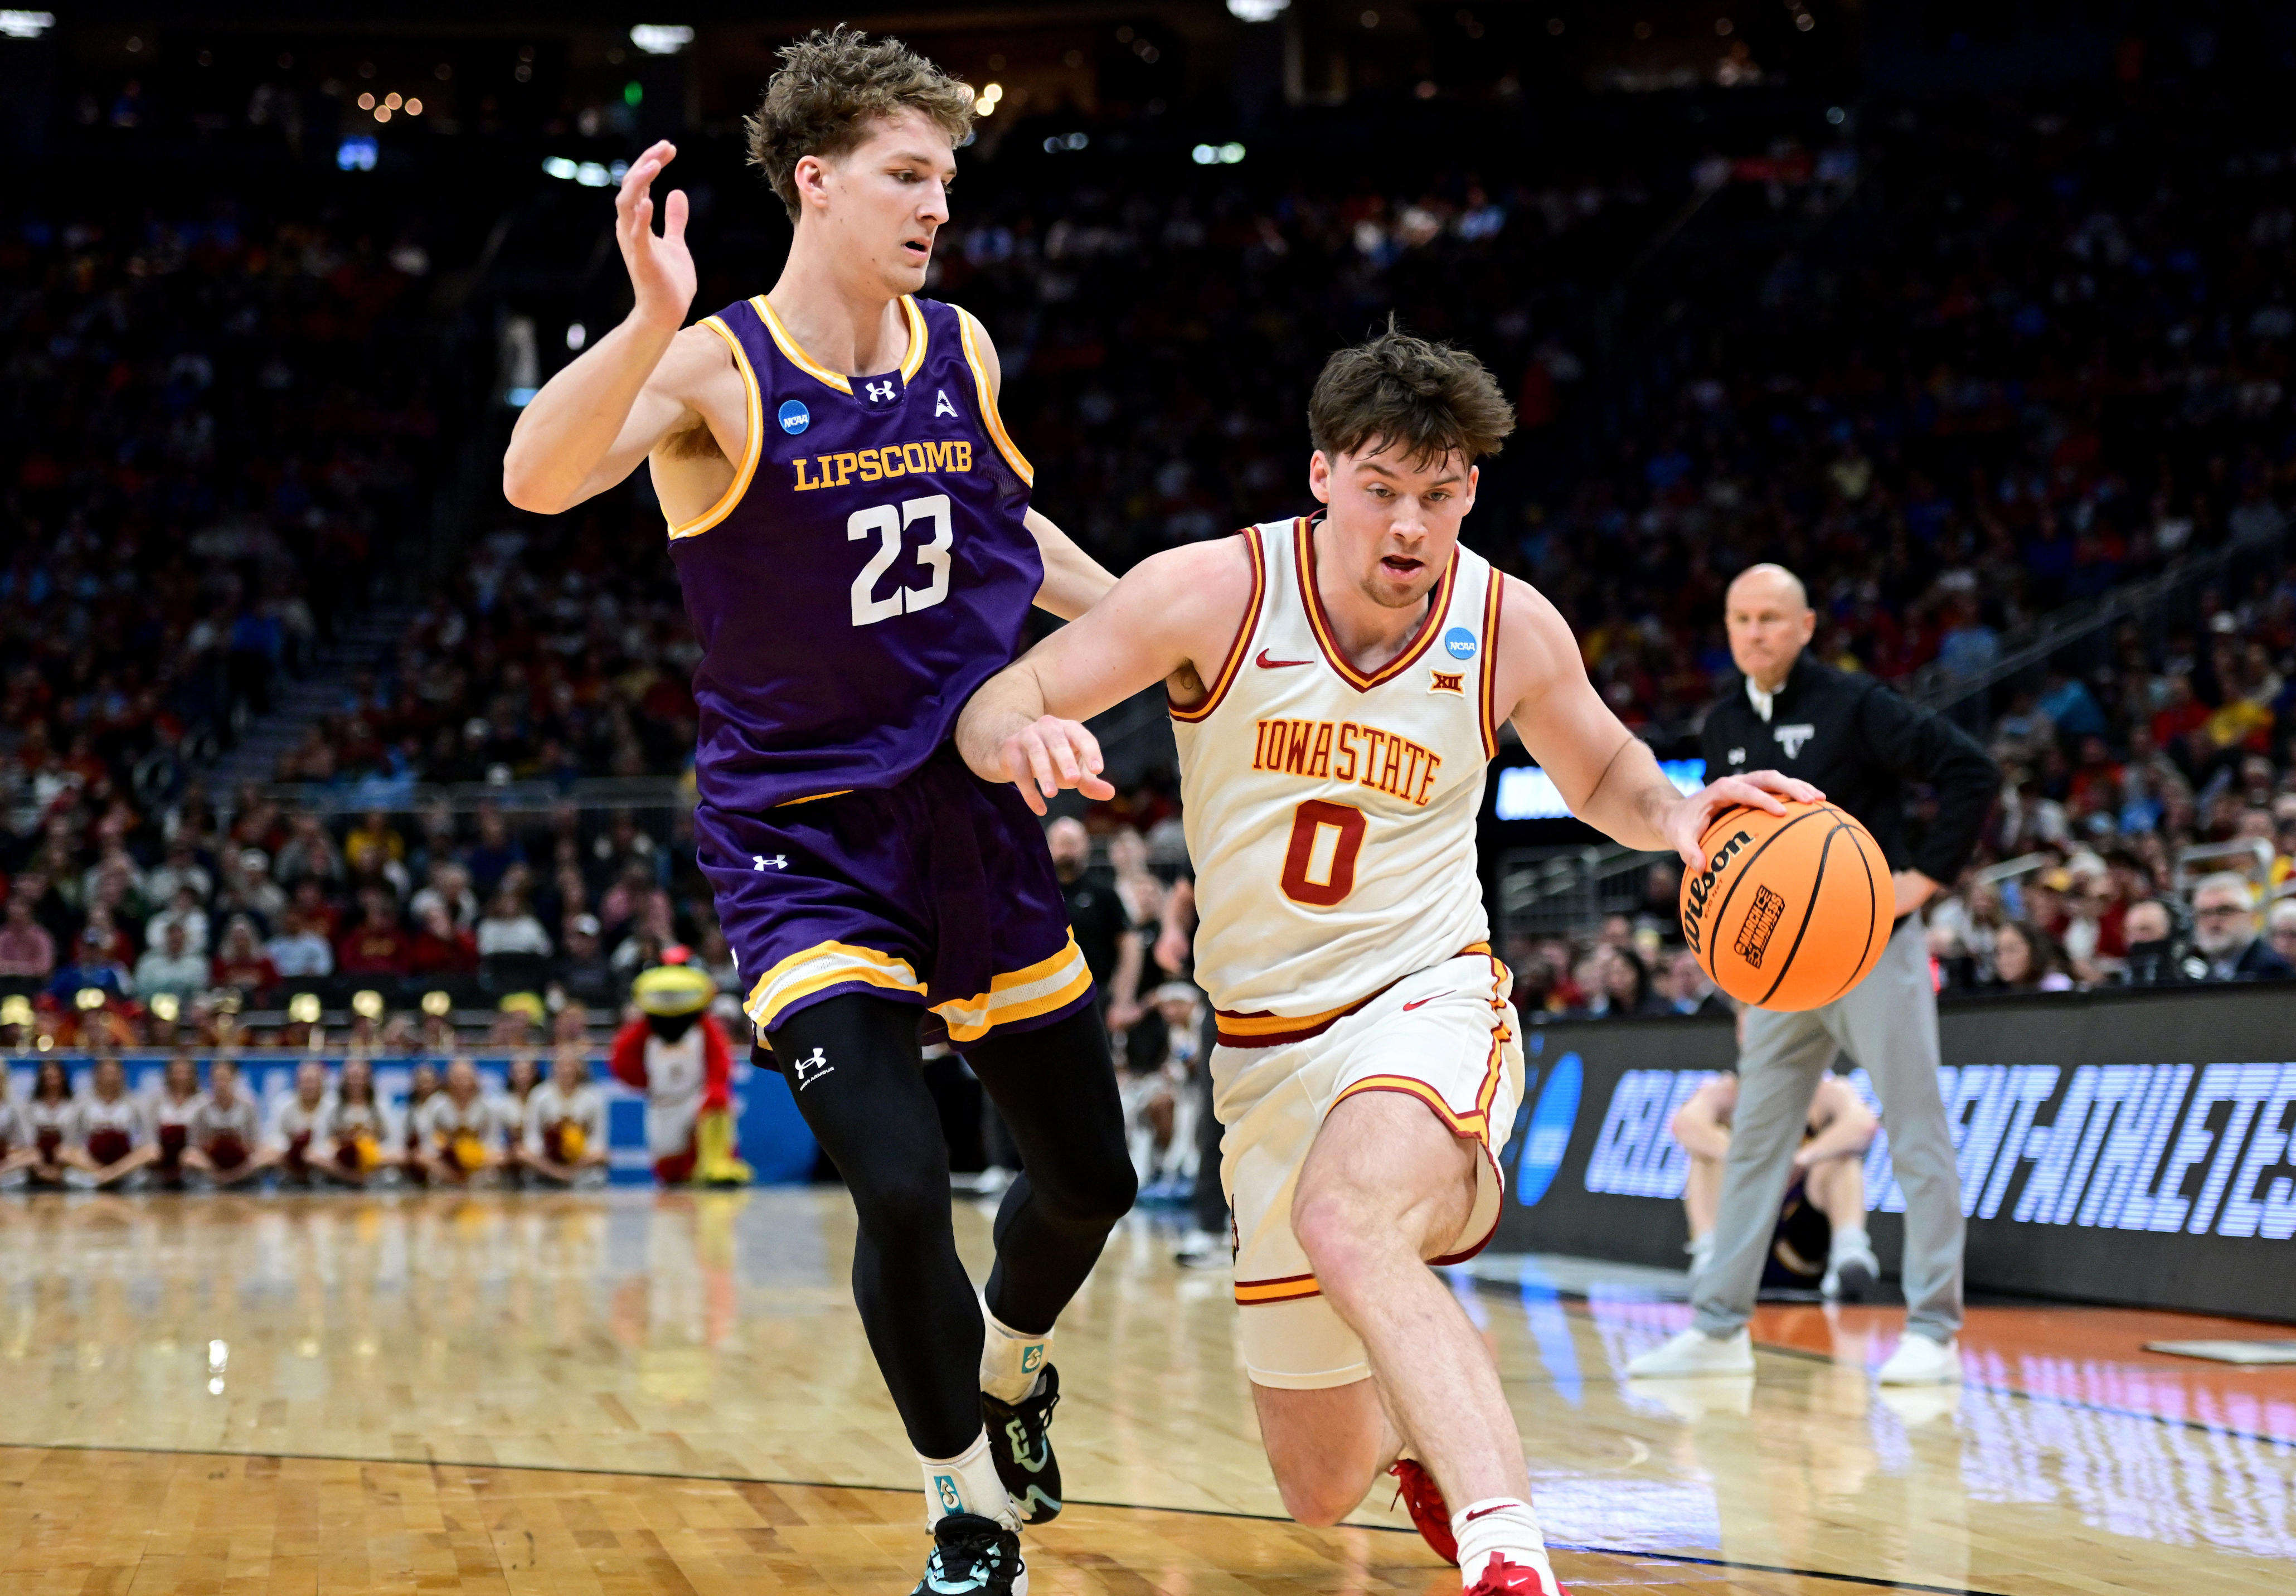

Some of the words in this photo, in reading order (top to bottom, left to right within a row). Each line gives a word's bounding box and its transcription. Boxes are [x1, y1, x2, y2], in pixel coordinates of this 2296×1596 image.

[783, 414, 808, 428] NCAA
[792, 440, 972, 491] LIPSCOMB
[847, 494, 953, 627] 23
[1450, 641, 1475, 651] NCAA
[1252, 719, 1333, 779] IOWA
[1336, 720, 1442, 807] STATE
[1279, 798, 1368, 908] 0
[1685, 830, 1756, 955] Wilson
[1739, 905, 1763, 948] MARCH
[1751, 893, 1783, 949] MADNESS
[810, 1066, 834, 1081] ARMOUR
